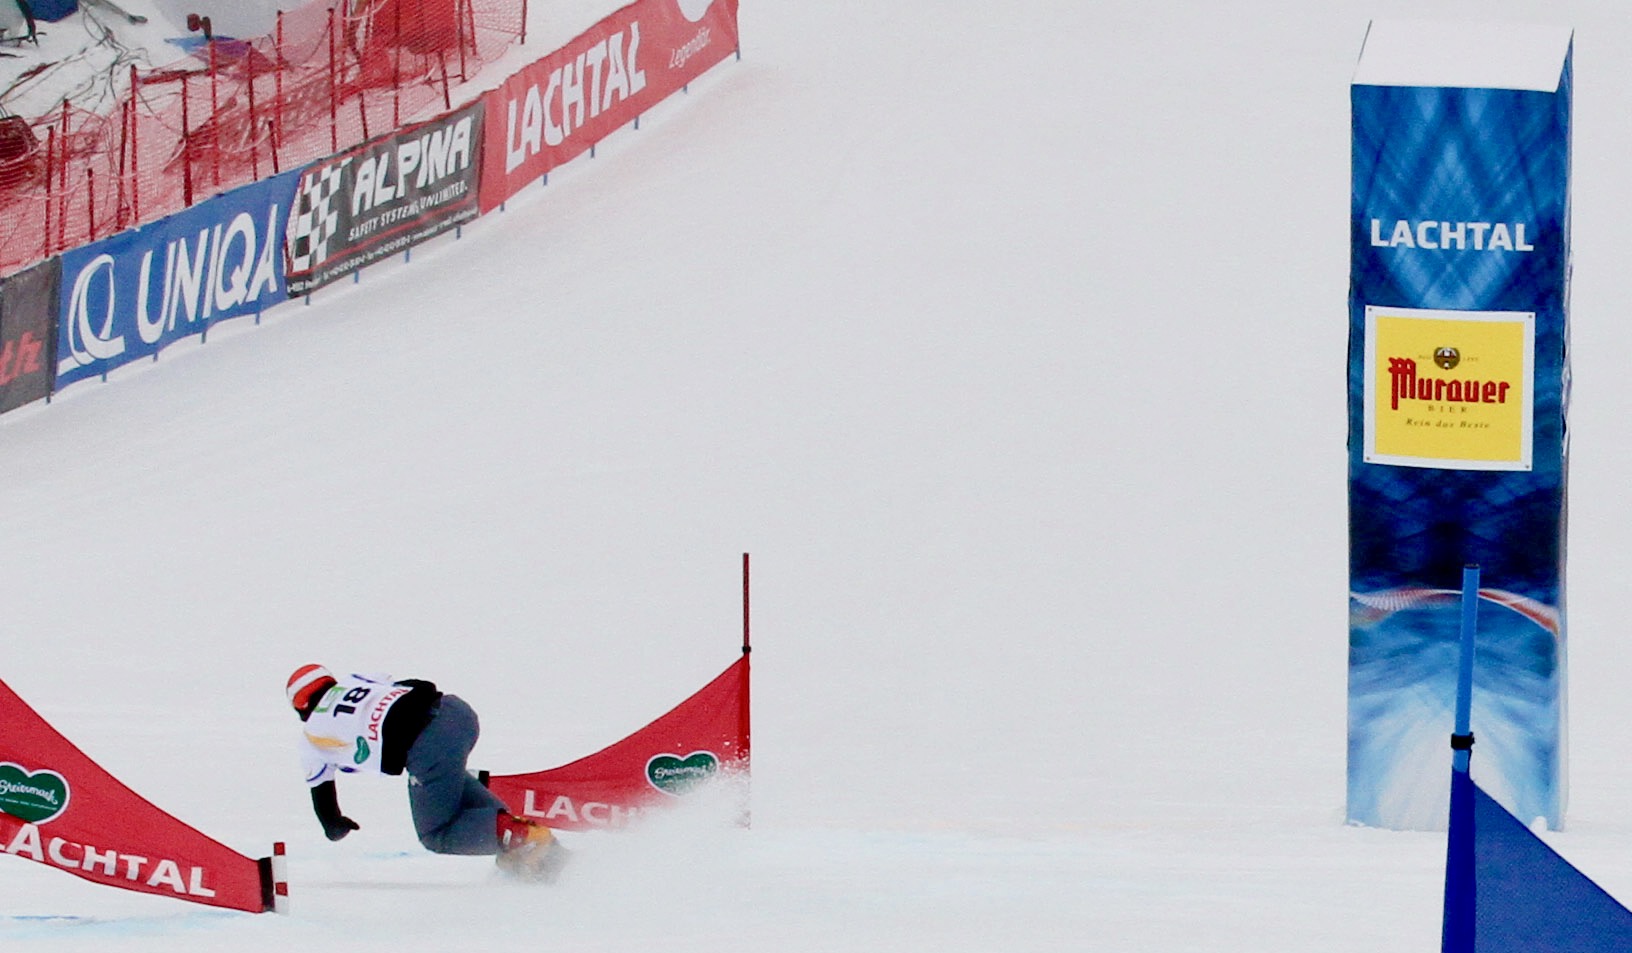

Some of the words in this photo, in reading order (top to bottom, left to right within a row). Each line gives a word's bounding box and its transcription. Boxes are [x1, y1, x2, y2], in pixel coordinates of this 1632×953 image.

[505, 21, 647, 175] LACHTAL
[352, 116, 472, 217] ALPINA
[348, 217, 379, 242] SAFETY
[1370, 218, 1535, 252] LACHTAL
[137, 204, 278, 344] UNIQA
[1388, 357, 1511, 411] Murauer
[333, 687, 371, 717] 18
[0, 823, 216, 898] ACHTAL
